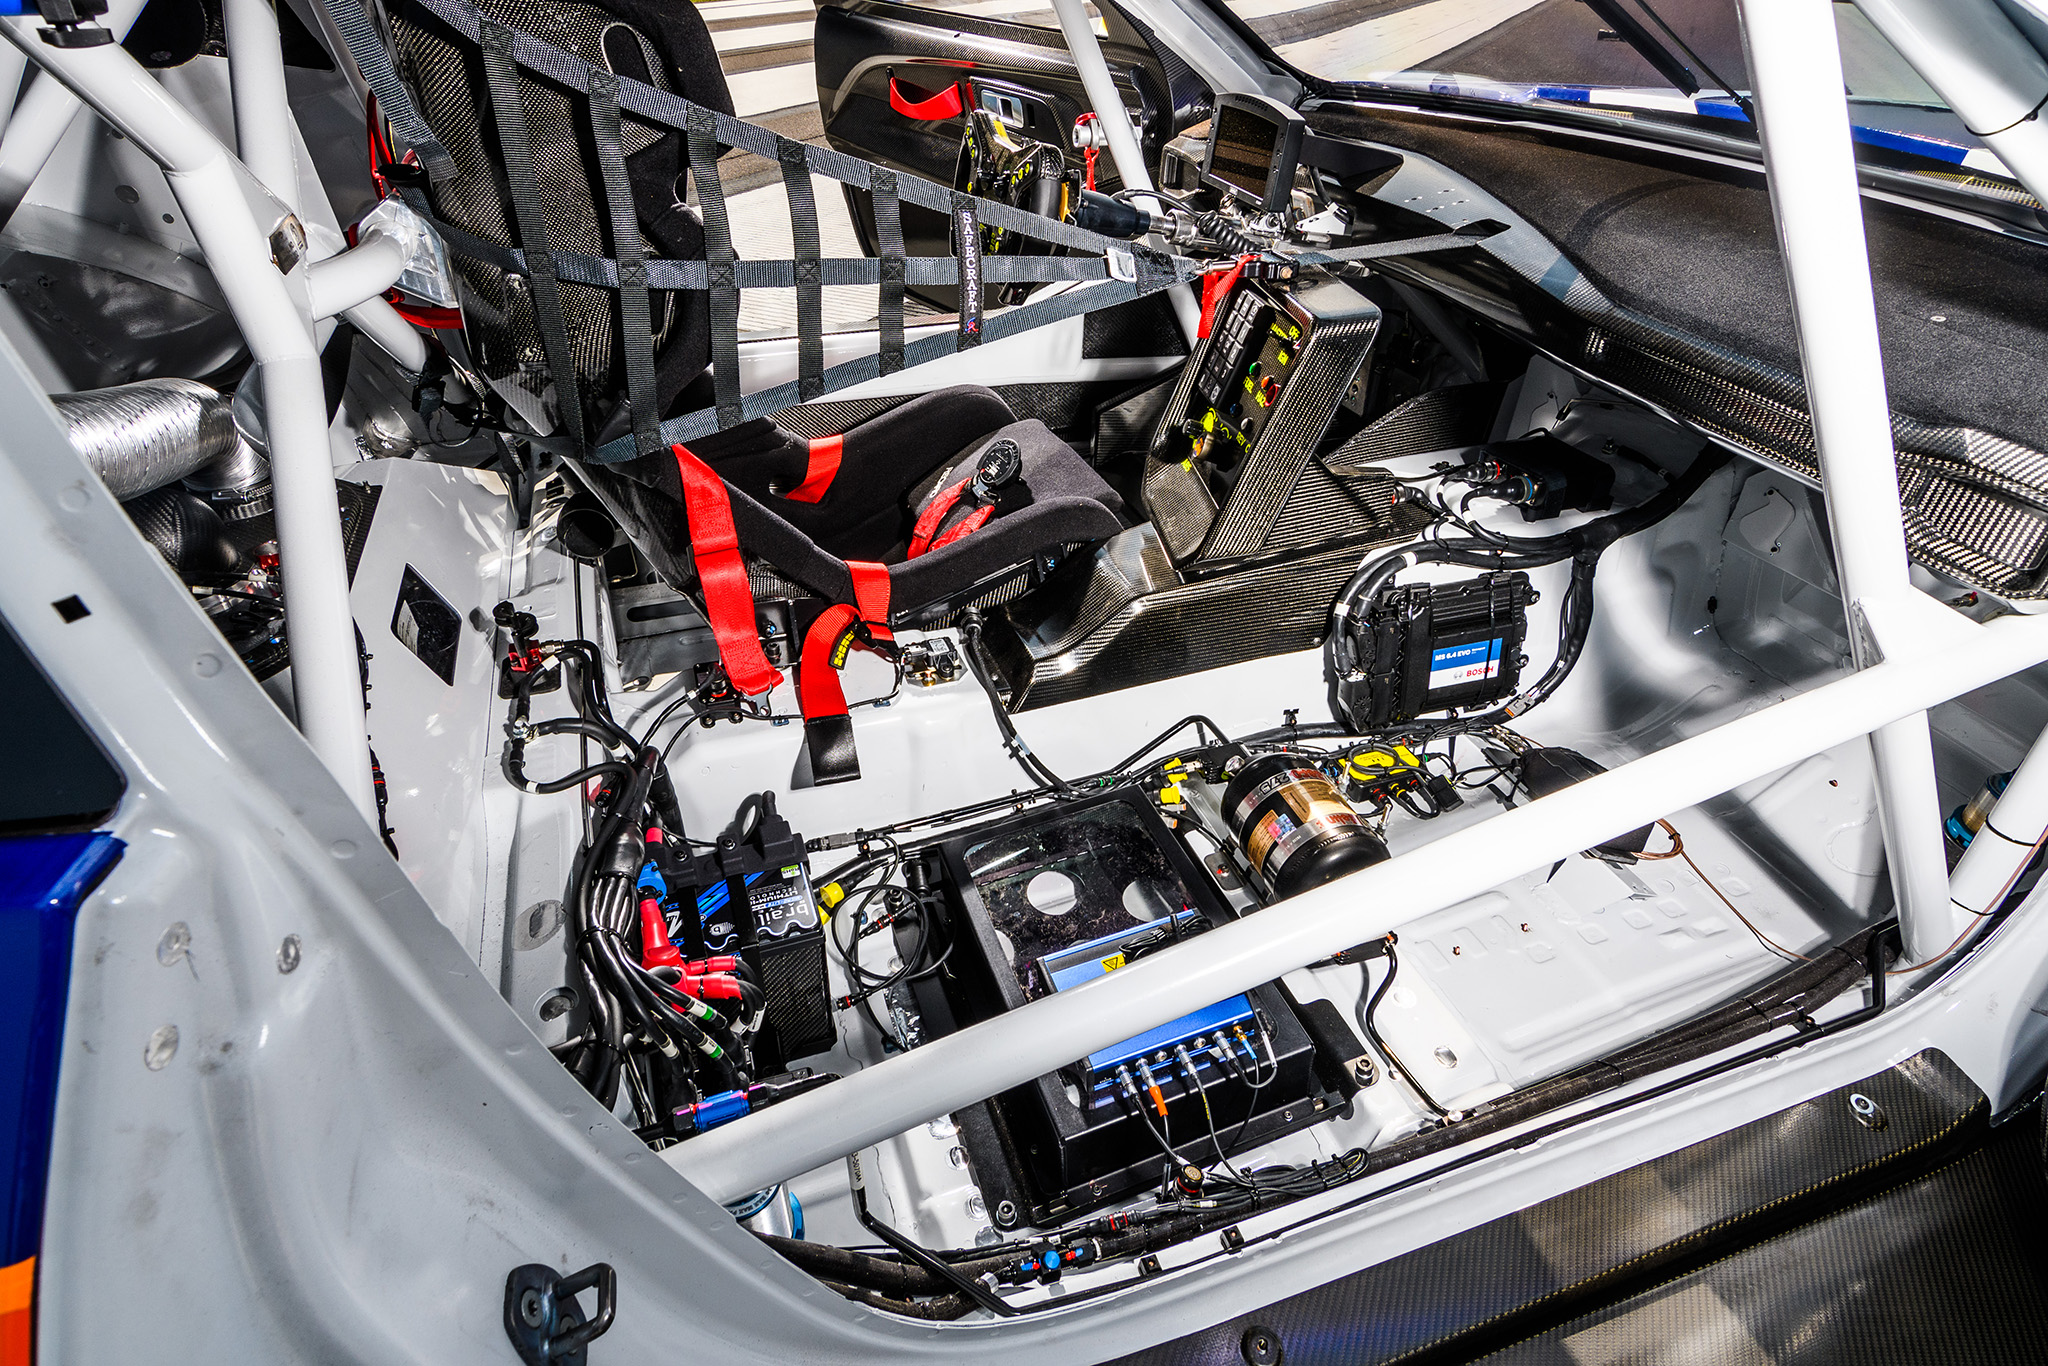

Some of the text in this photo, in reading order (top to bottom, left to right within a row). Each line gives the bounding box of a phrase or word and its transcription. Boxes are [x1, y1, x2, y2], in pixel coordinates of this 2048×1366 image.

[961, 211, 980, 315] SAFECRAFT
[1289, 325, 1301, 340] OFF
[1243, 376, 1254, 394] FUEL
[1446, 651, 1457, 659] 6.4
[1457, 649, 1471, 657] EVO
[1466, 666, 1494, 678] BOSCH
[1260, 774, 1290, 795] 275
